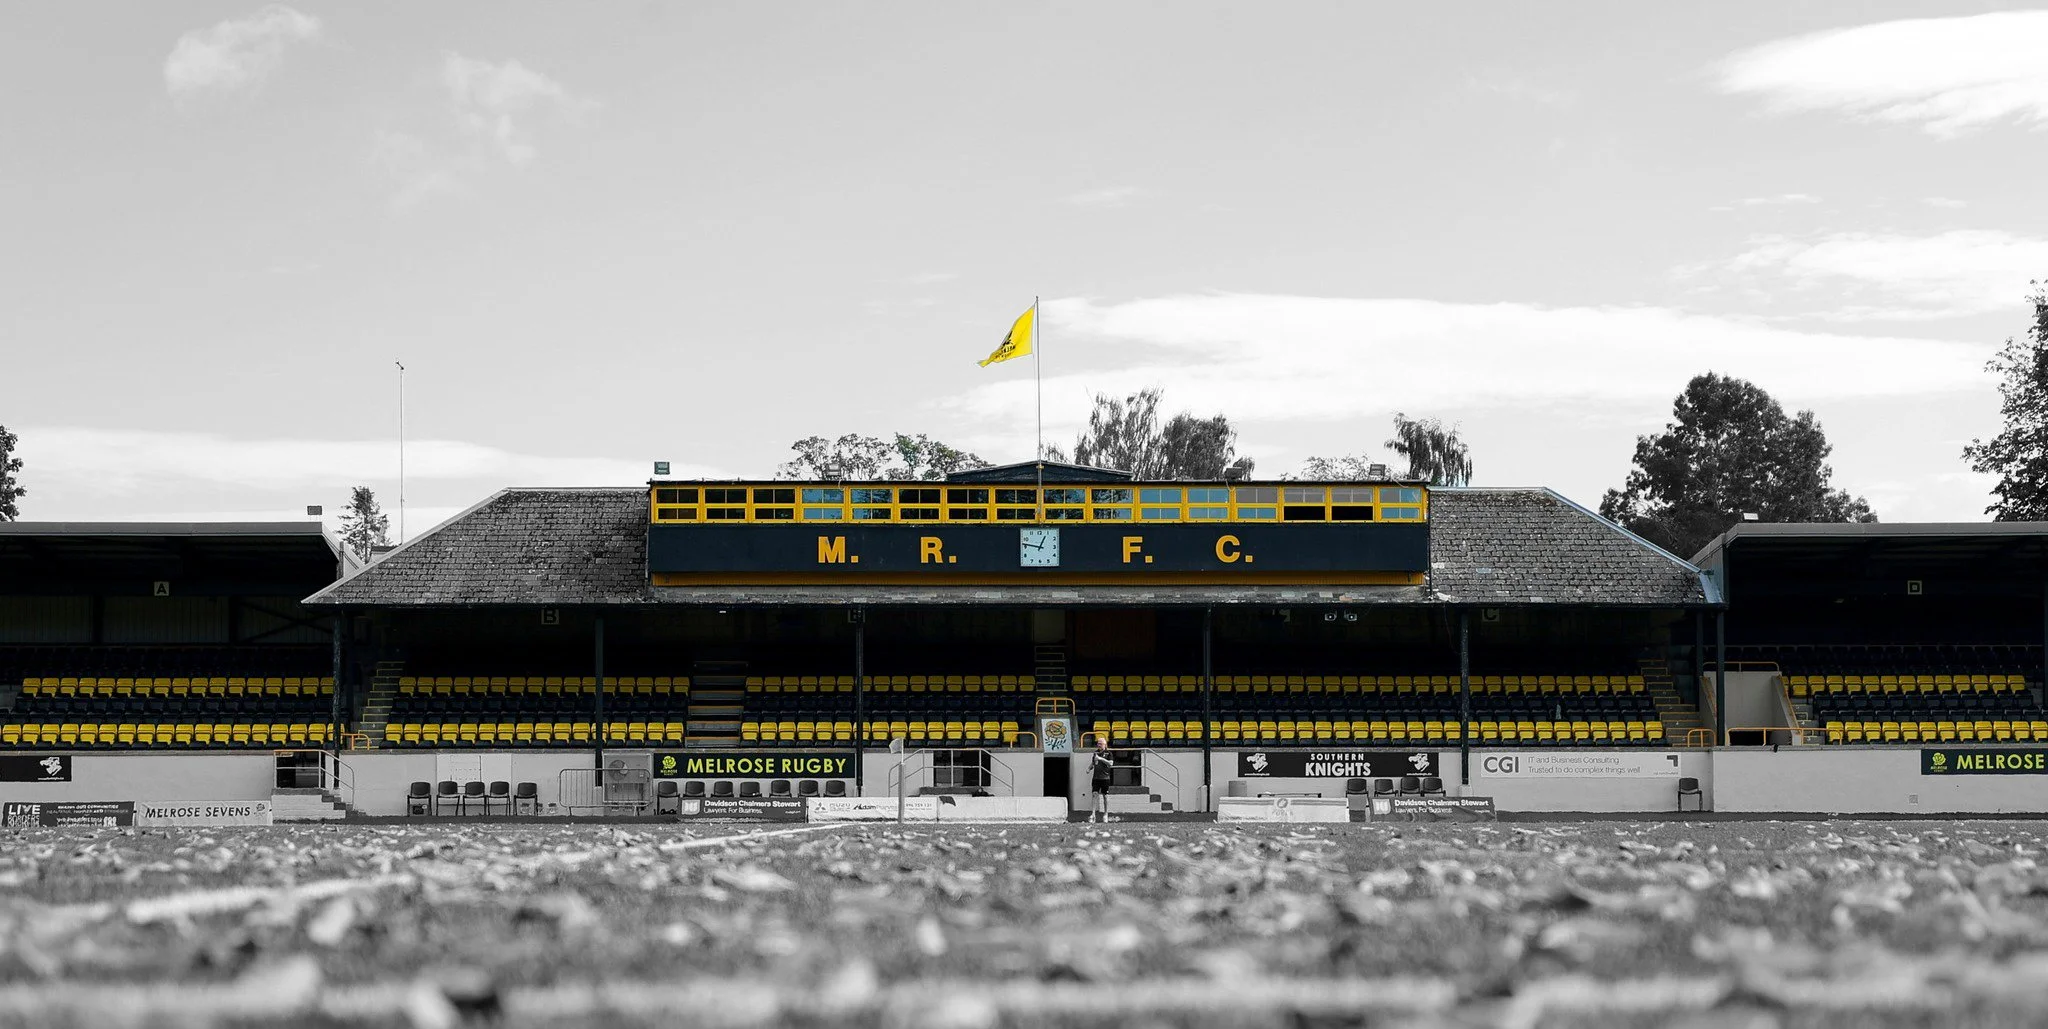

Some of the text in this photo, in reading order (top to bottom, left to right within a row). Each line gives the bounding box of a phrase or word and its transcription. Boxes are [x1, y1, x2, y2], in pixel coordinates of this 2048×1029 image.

[818, 535, 1252, 563] M. R. F. C.
[157, 583, 166, 594] A
[544, 609, 556, 623] B
[1484, 608, 1496, 620] C
[686, 758, 846, 773] MELROSE RUGBY
[1483, 756, 1519, 773] CGI
[1583, 756, 1619, 765] Consulting
[1956, 754, 2044, 769] MELROSE
[1305, 763, 1371, 776] KNIGHTS
[1575, 766, 1603, 775] complex
[1605, 766, 1626, 775] things
[8, 804, 40, 815] LIVE
[145, 807, 250, 818] MELROSE SEVENS
